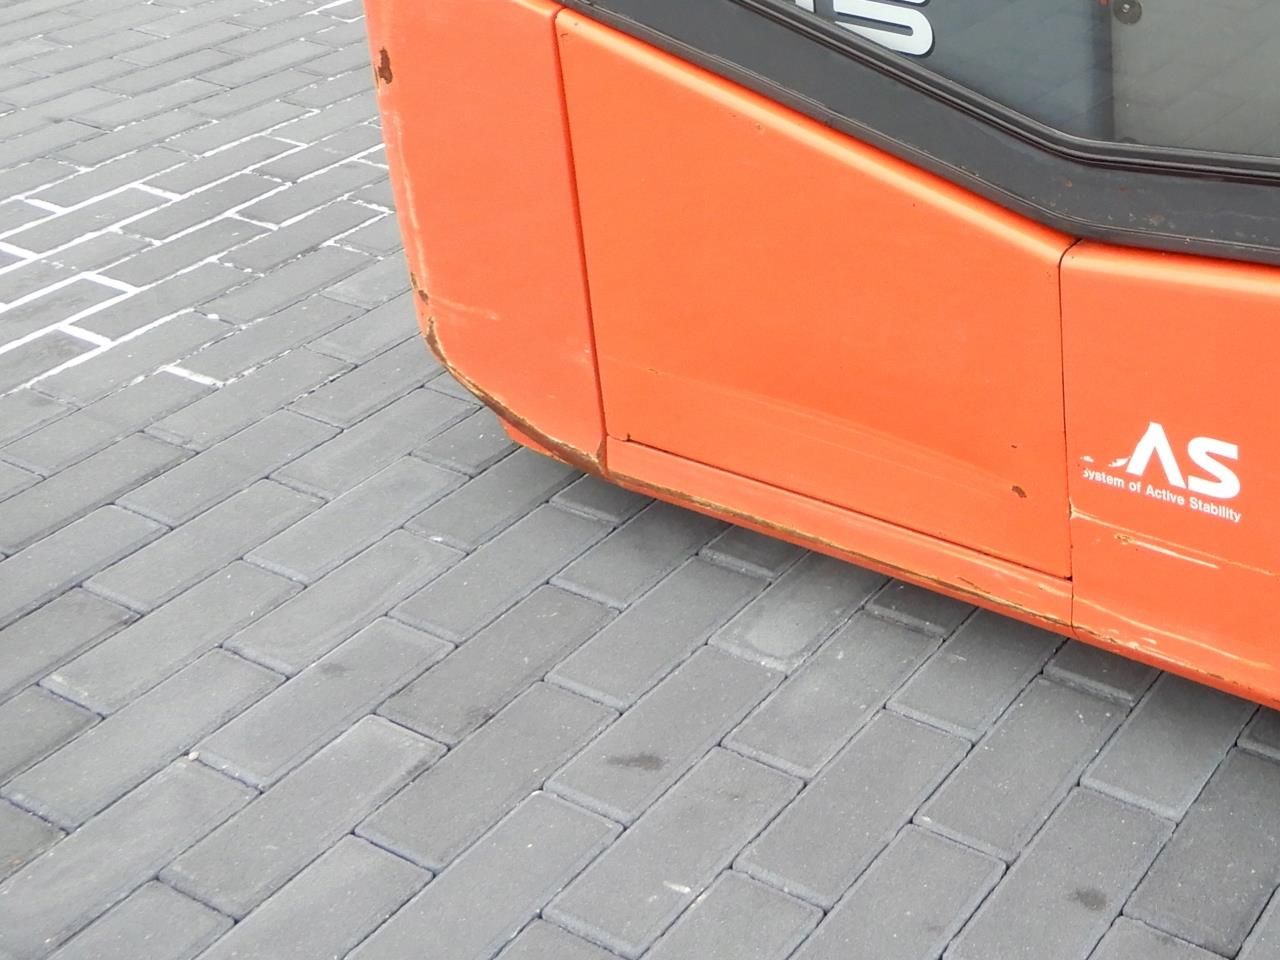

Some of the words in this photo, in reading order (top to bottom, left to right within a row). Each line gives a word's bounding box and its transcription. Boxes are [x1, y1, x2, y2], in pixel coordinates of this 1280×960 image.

[1081, 421, 1241, 499] AS
[1128, 481, 1142, 494] of
[1145, 486, 1185, 506] Active
[1190, 498, 1242, 523] Stability
